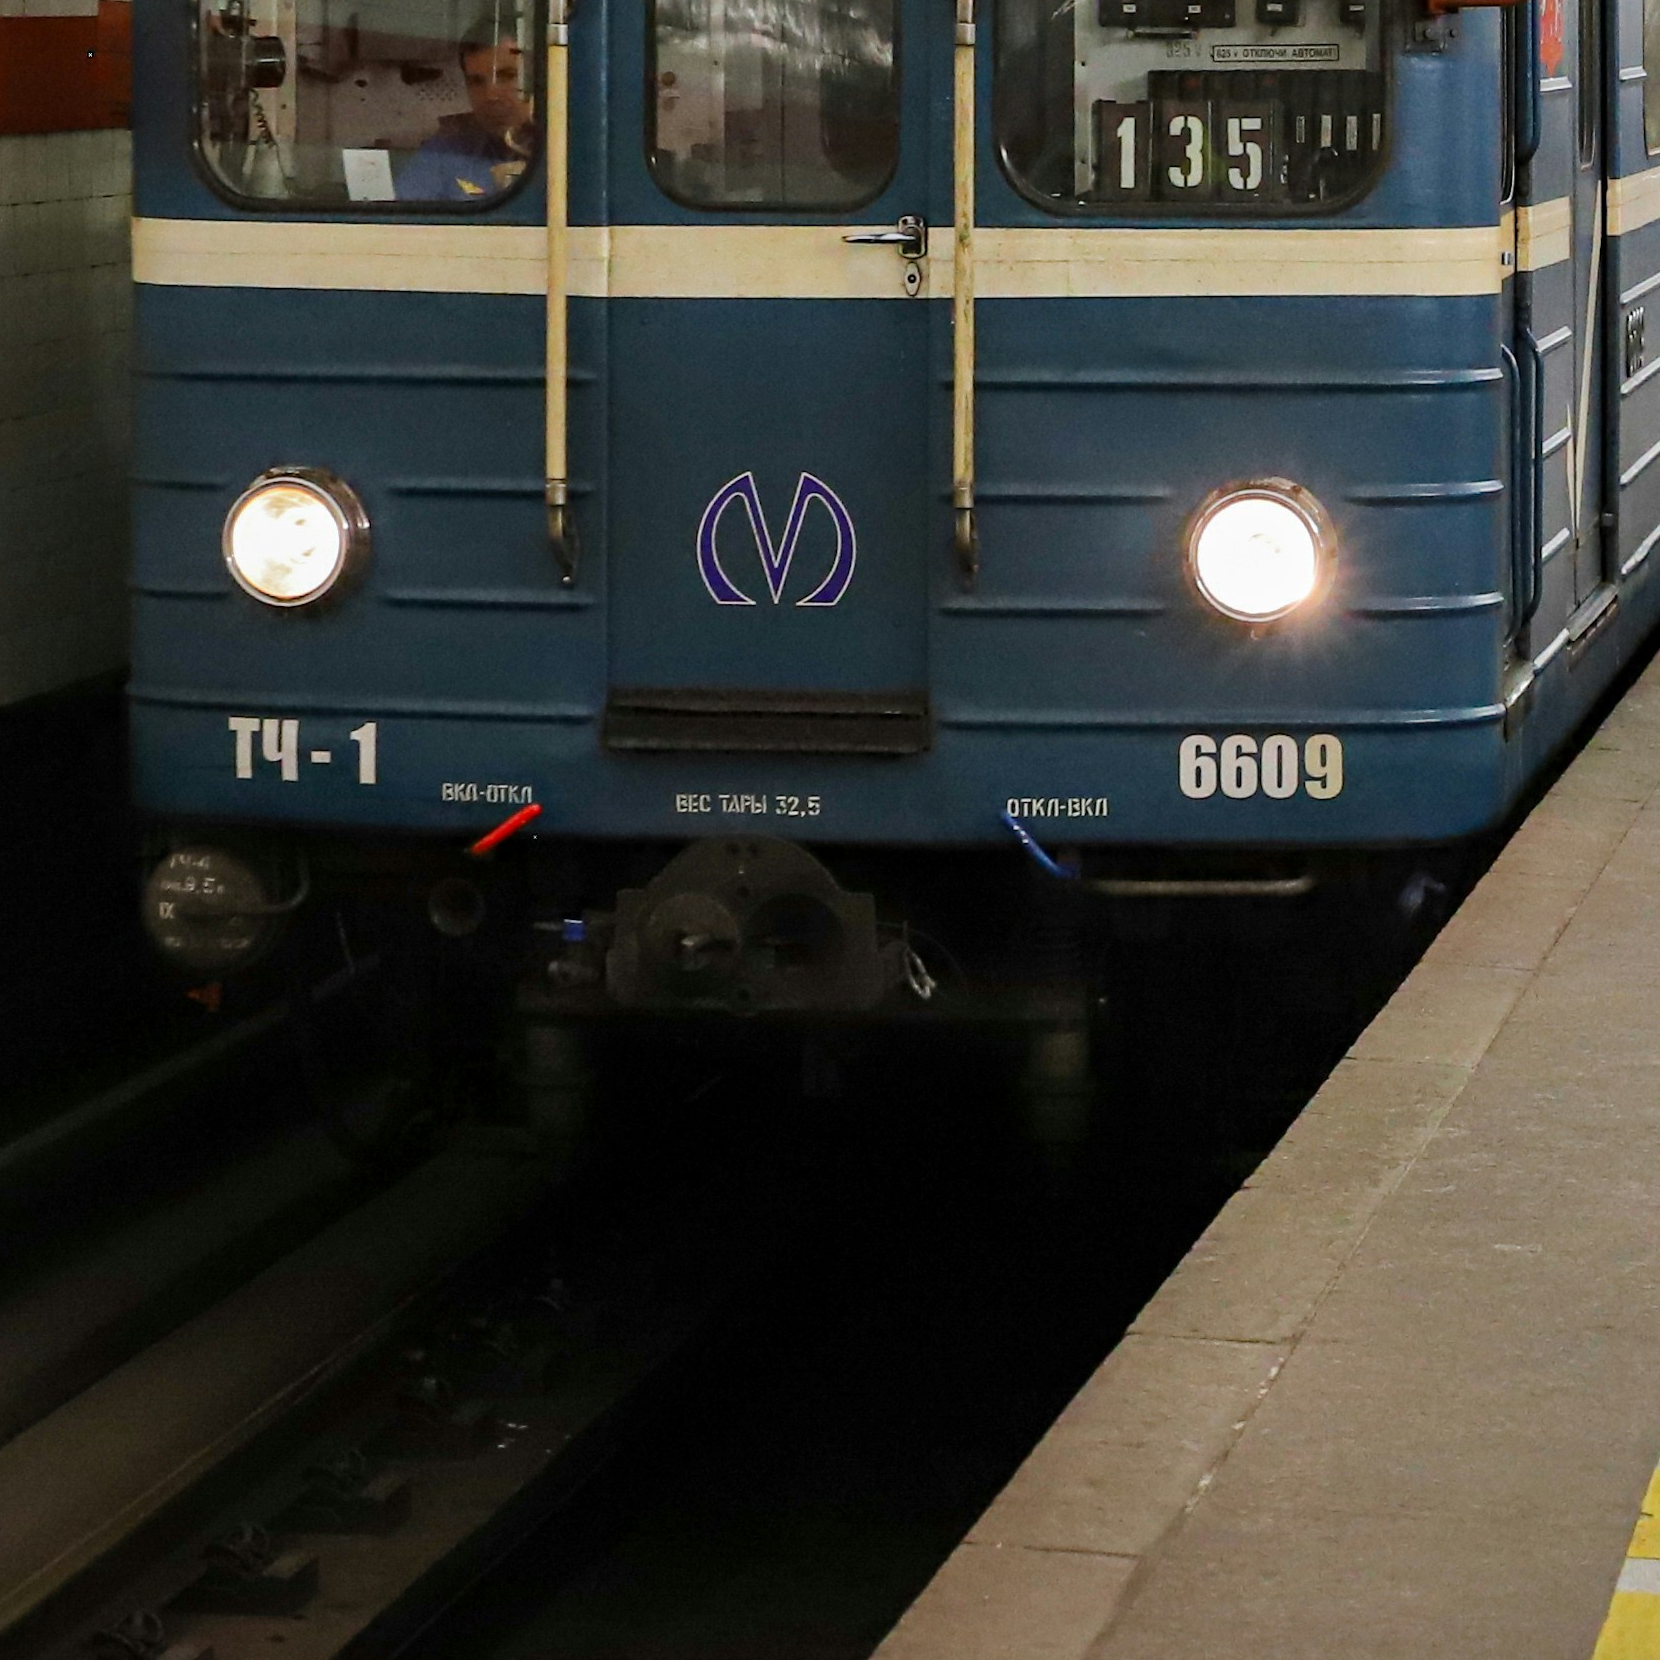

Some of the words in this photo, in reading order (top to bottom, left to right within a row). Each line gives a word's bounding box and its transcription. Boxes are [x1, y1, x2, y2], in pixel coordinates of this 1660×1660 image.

[1242, 48, 1287, 58] ОТКЛЮЧИ
[1292, 47, 1333, 58] АВТОМАТ
[1117, 116, 1262, 190] 135
[1179, 733, 1344, 799] 6609
[442, 783, 533, 804] ВКЛ-ОТКЛ
[675, 794, 711, 813] ВЕС
[718, 794, 767, 814] ТАРЫ
[775, 795, 821, 817] 32,5
[1006, 797, 1108, 817] ОТКЛ-ВКЛ
